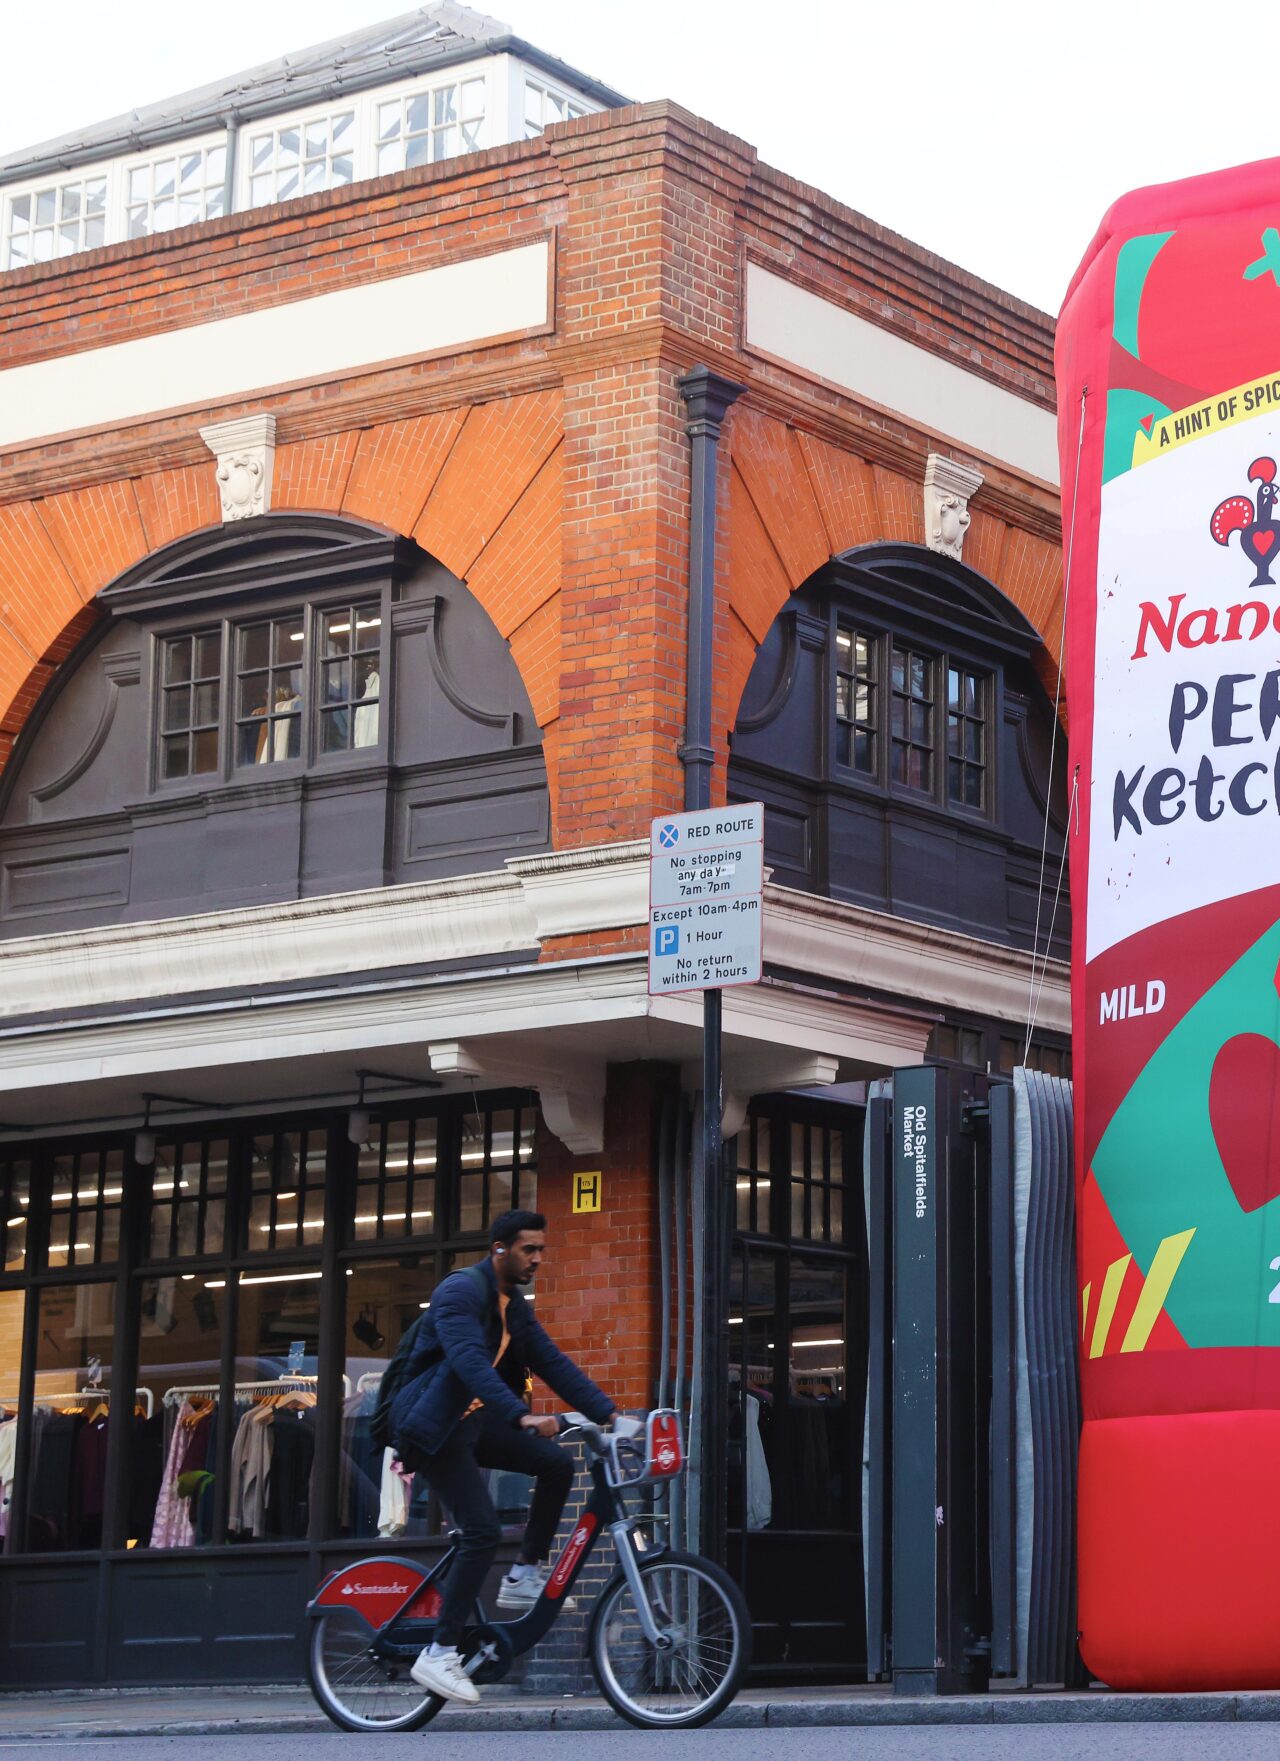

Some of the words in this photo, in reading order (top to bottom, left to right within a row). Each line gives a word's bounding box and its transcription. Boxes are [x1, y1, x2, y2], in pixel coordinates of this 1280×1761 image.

[1159, 426, 1171, 448] A
[1174, 406, 1212, 441] HINT
[1217, 396, 1238, 422] OF
[687, 825, 710, 839] RED
[716, 818, 754, 834] ROUTE
[670, 857, 686, 868] No
[691, 850, 742, 865] stopping
[678, 870, 696, 882] any
[653, 907, 693, 922] Except
[660, 929, 675, 953] P
[686, 932, 691, 943] 1
[696, 930, 723, 942] Hour
[677, 958, 692, 969] No
[697, 954, 733, 967] return
[662, 971, 697, 985] within
[703, 969, 710, 980] 2
[716, 966, 748, 979] hours
[1099, 978, 1166, 1026] MILD
[915, 1105, 927, 1131] Old
[903, 1106, 915, 1158] Market
[913, 1134, 927, 1218] Spitalfields
[577, 1175, 597, 1208] H
[353, 1581, 410, 1595] Santander
